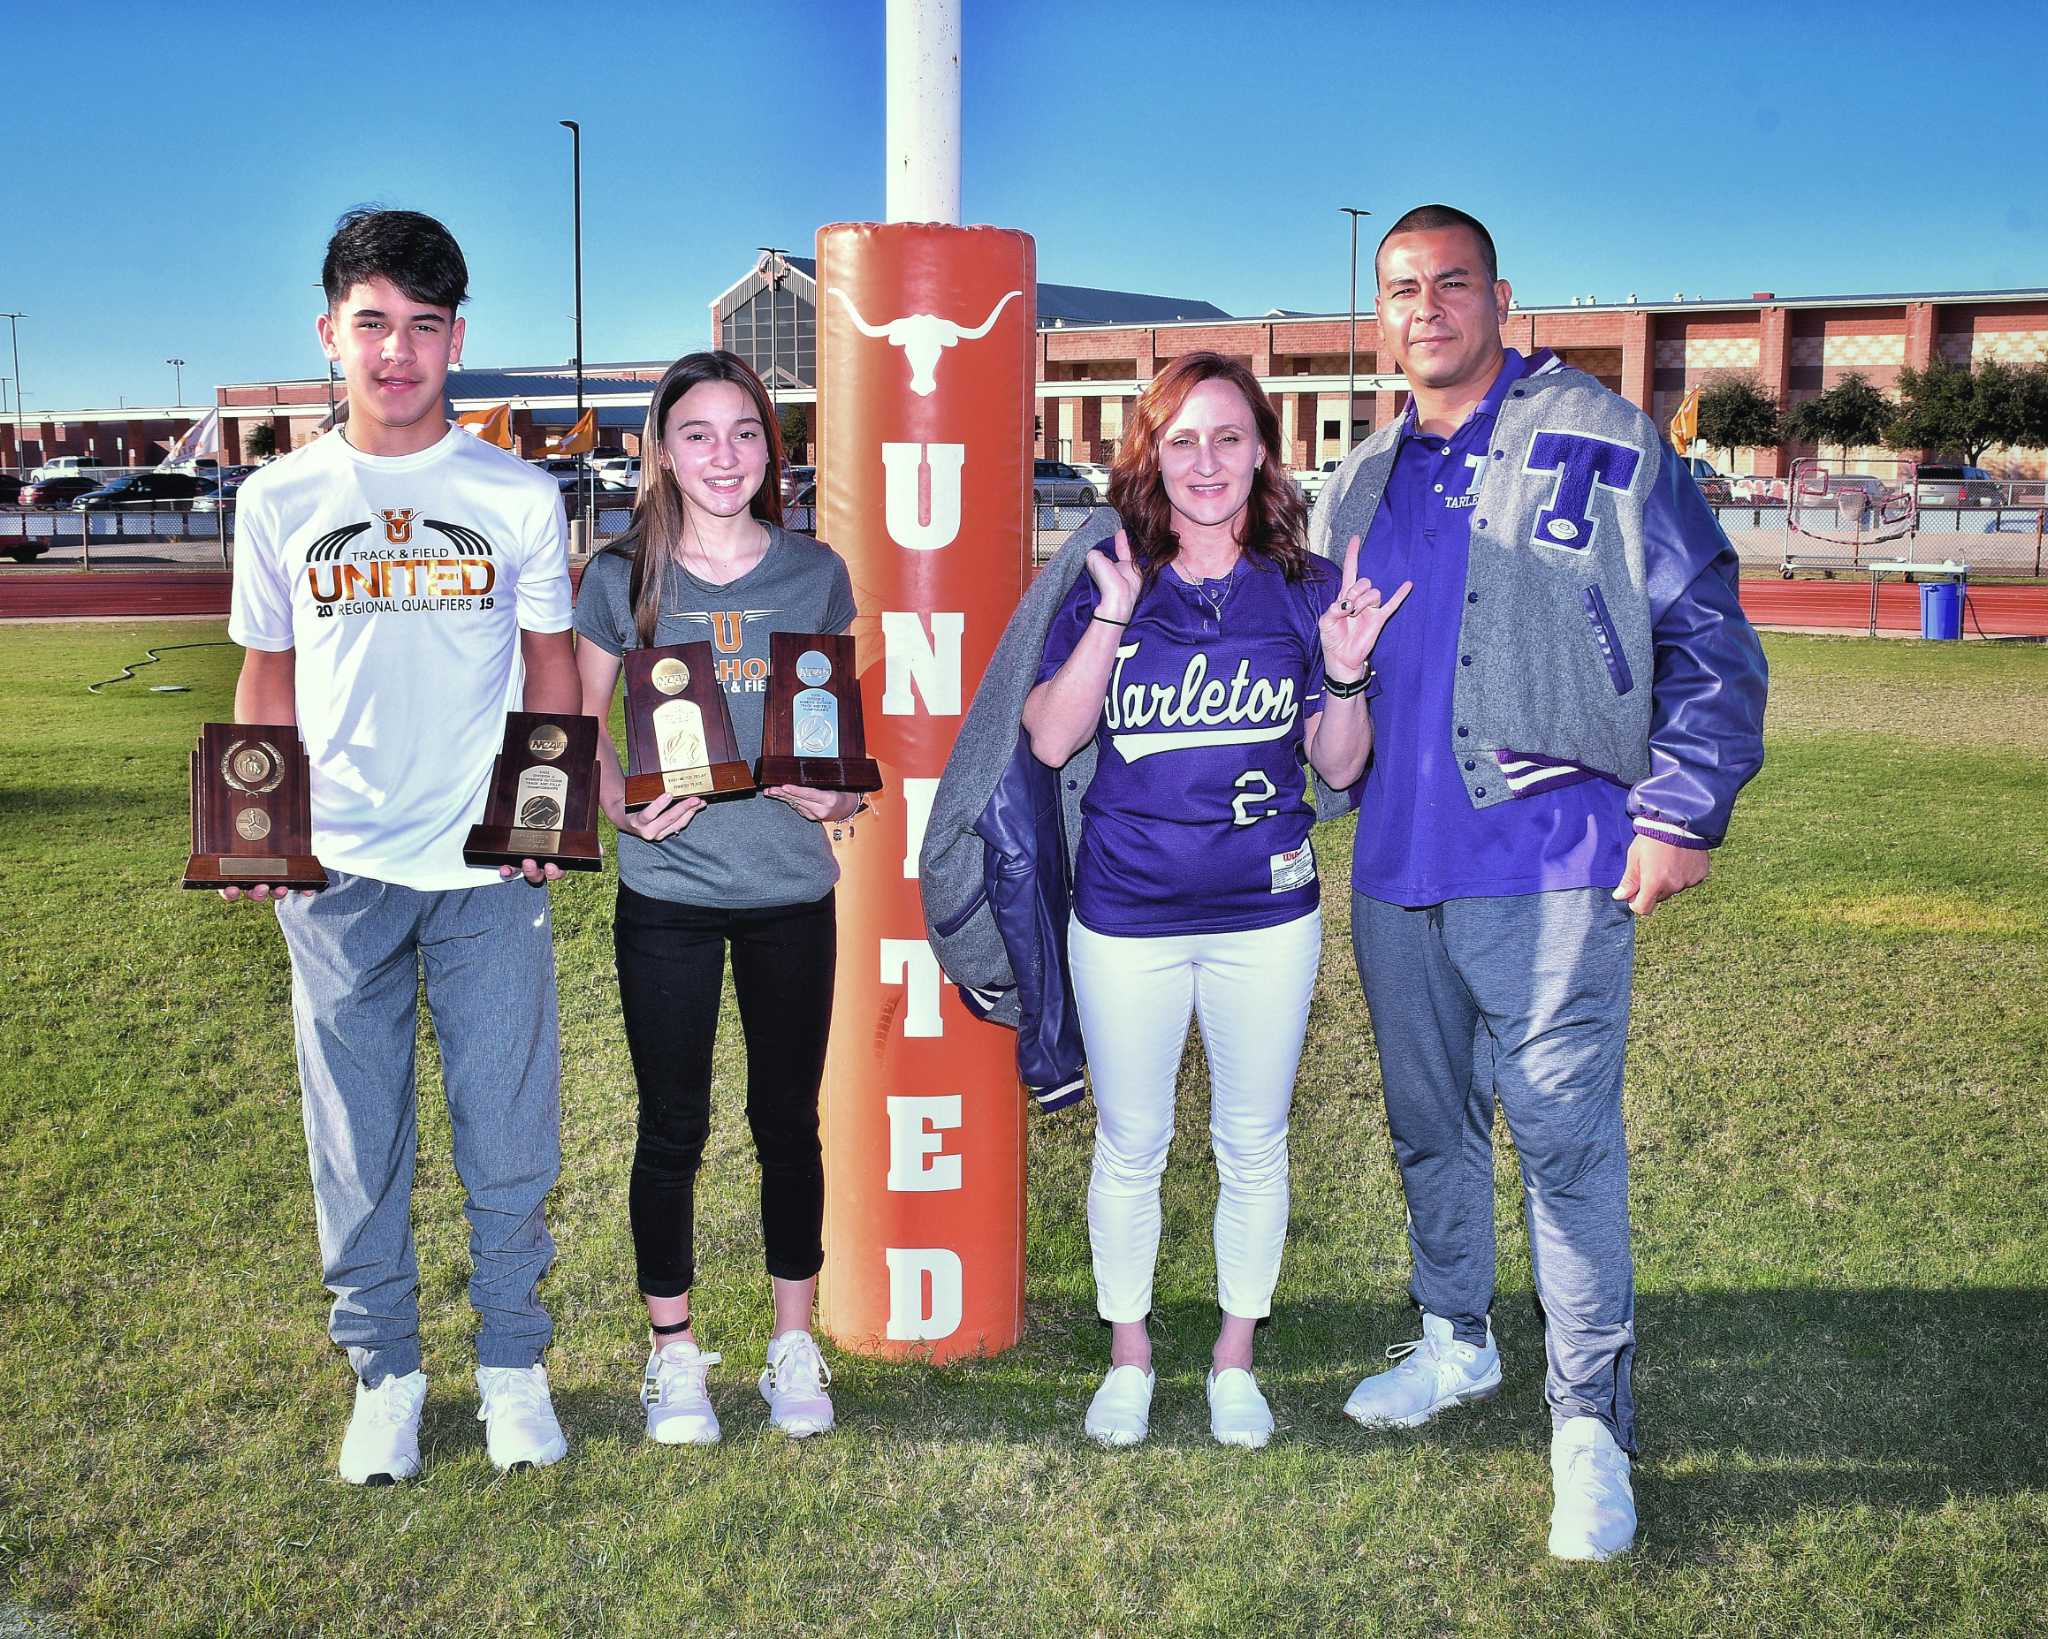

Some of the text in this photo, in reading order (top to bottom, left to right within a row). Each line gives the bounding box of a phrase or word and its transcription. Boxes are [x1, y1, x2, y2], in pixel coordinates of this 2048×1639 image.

[1521, 429, 1645, 556] T
[381, 508, 414, 544] U
[351, 548, 449, 562] TRACK & FIELD
[308, 559, 496, 604] UNITED
[316, 597, 494, 618] 20 REGIONAL QUALIFIERS 19
[709, 611, 744, 654] U
[1105, 642, 1298, 730] Tarleton
[1232, 770, 1278, 825] 2
